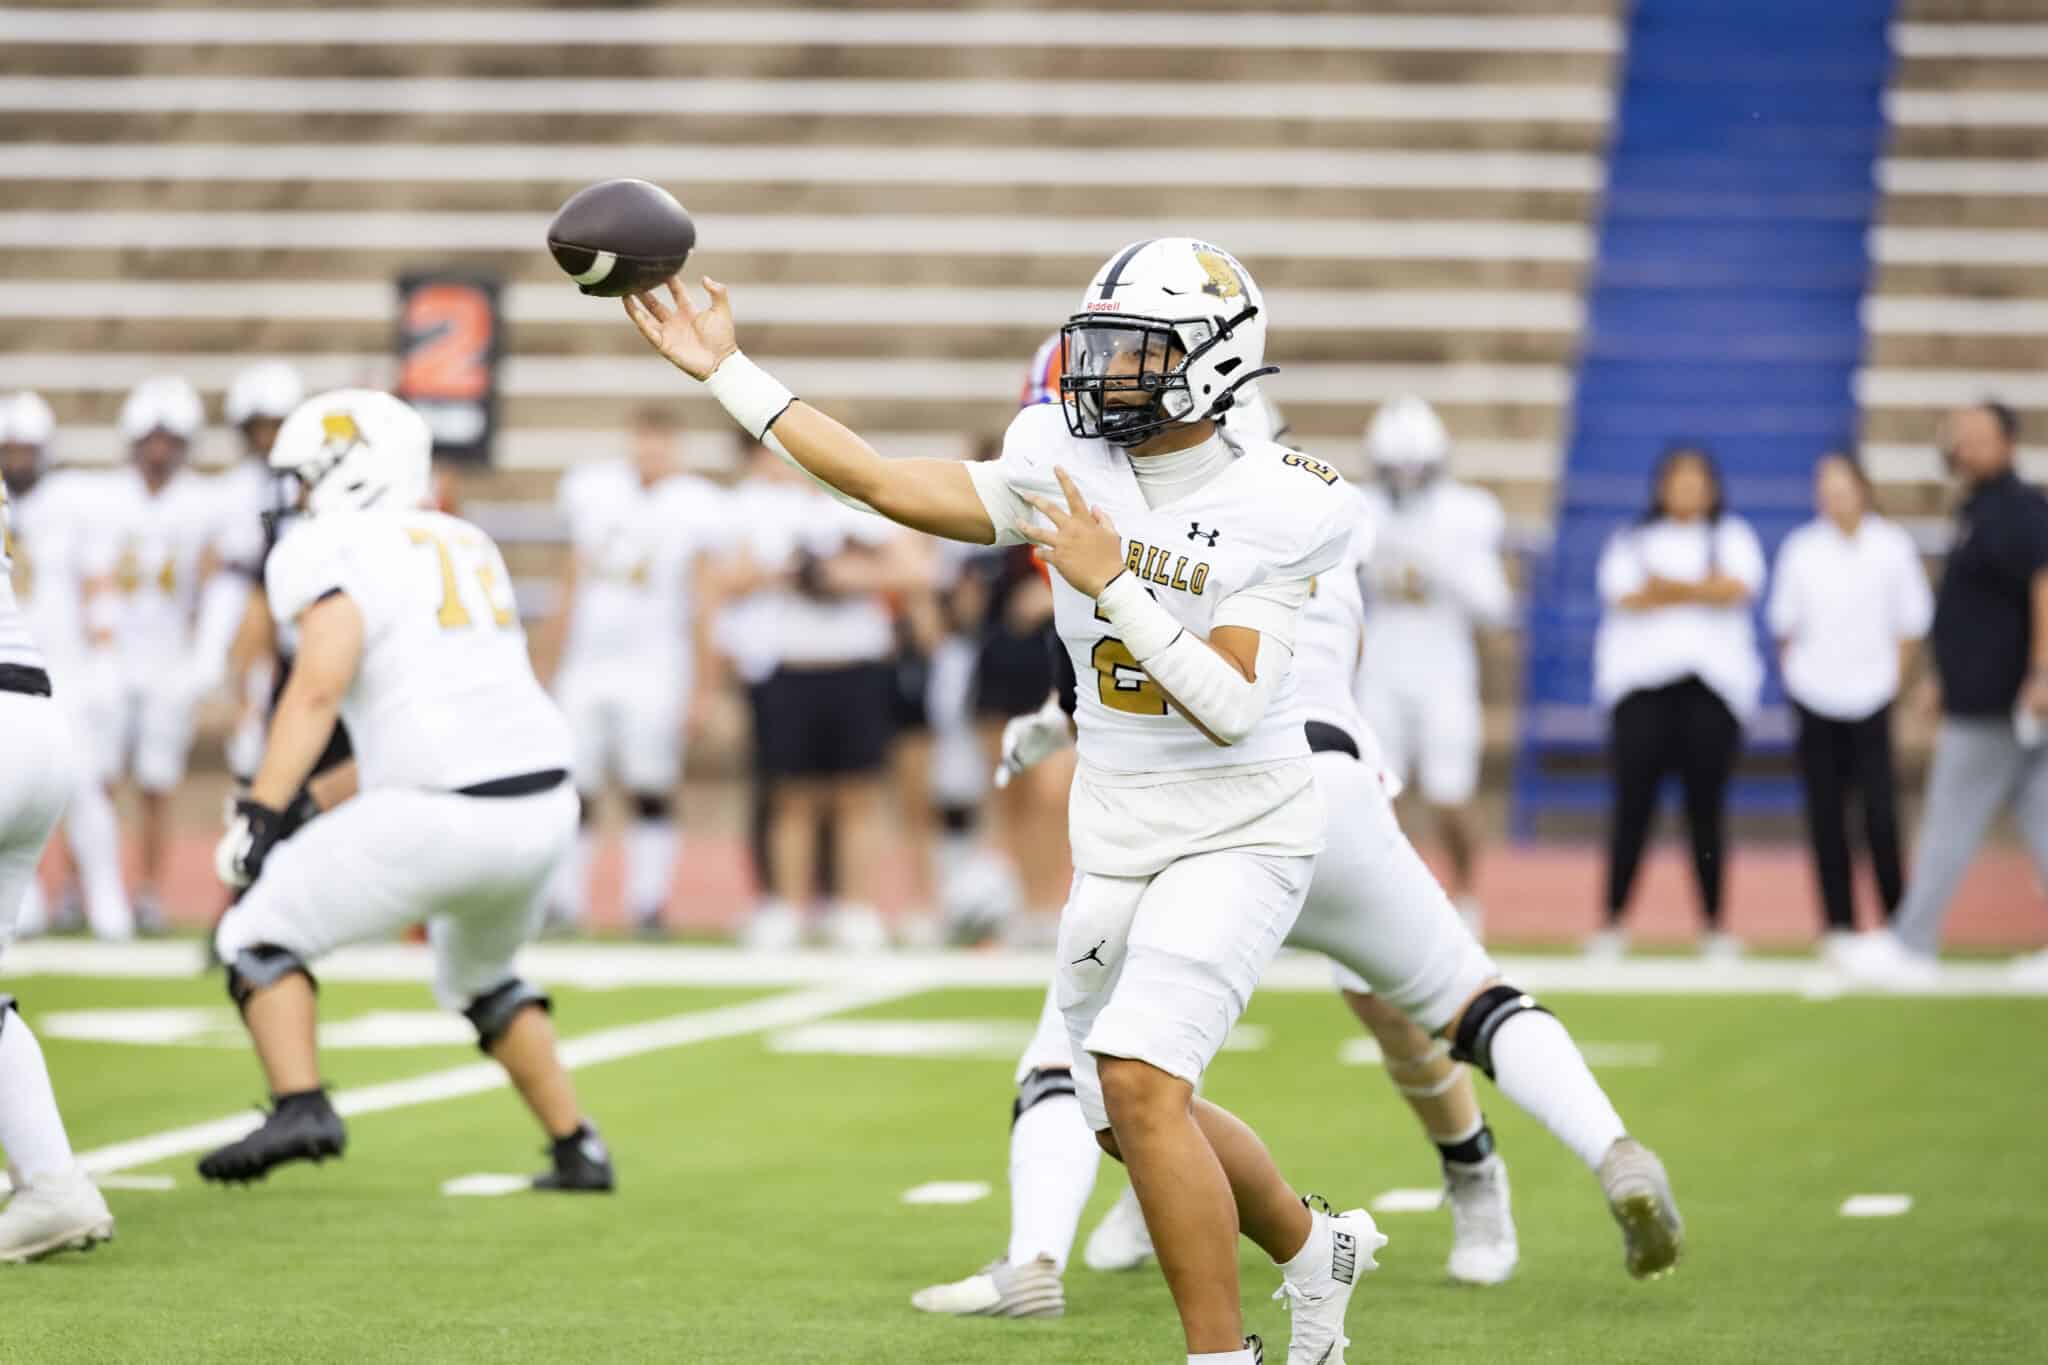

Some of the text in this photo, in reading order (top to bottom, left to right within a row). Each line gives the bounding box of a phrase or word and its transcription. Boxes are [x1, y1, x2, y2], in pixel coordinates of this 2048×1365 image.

[1087, 302, 1120, 312] Riddell
[402, 281, 491, 399] 2
[1282, 454, 1338, 486] 2
[1332, 1231, 1355, 1285] NIKE
